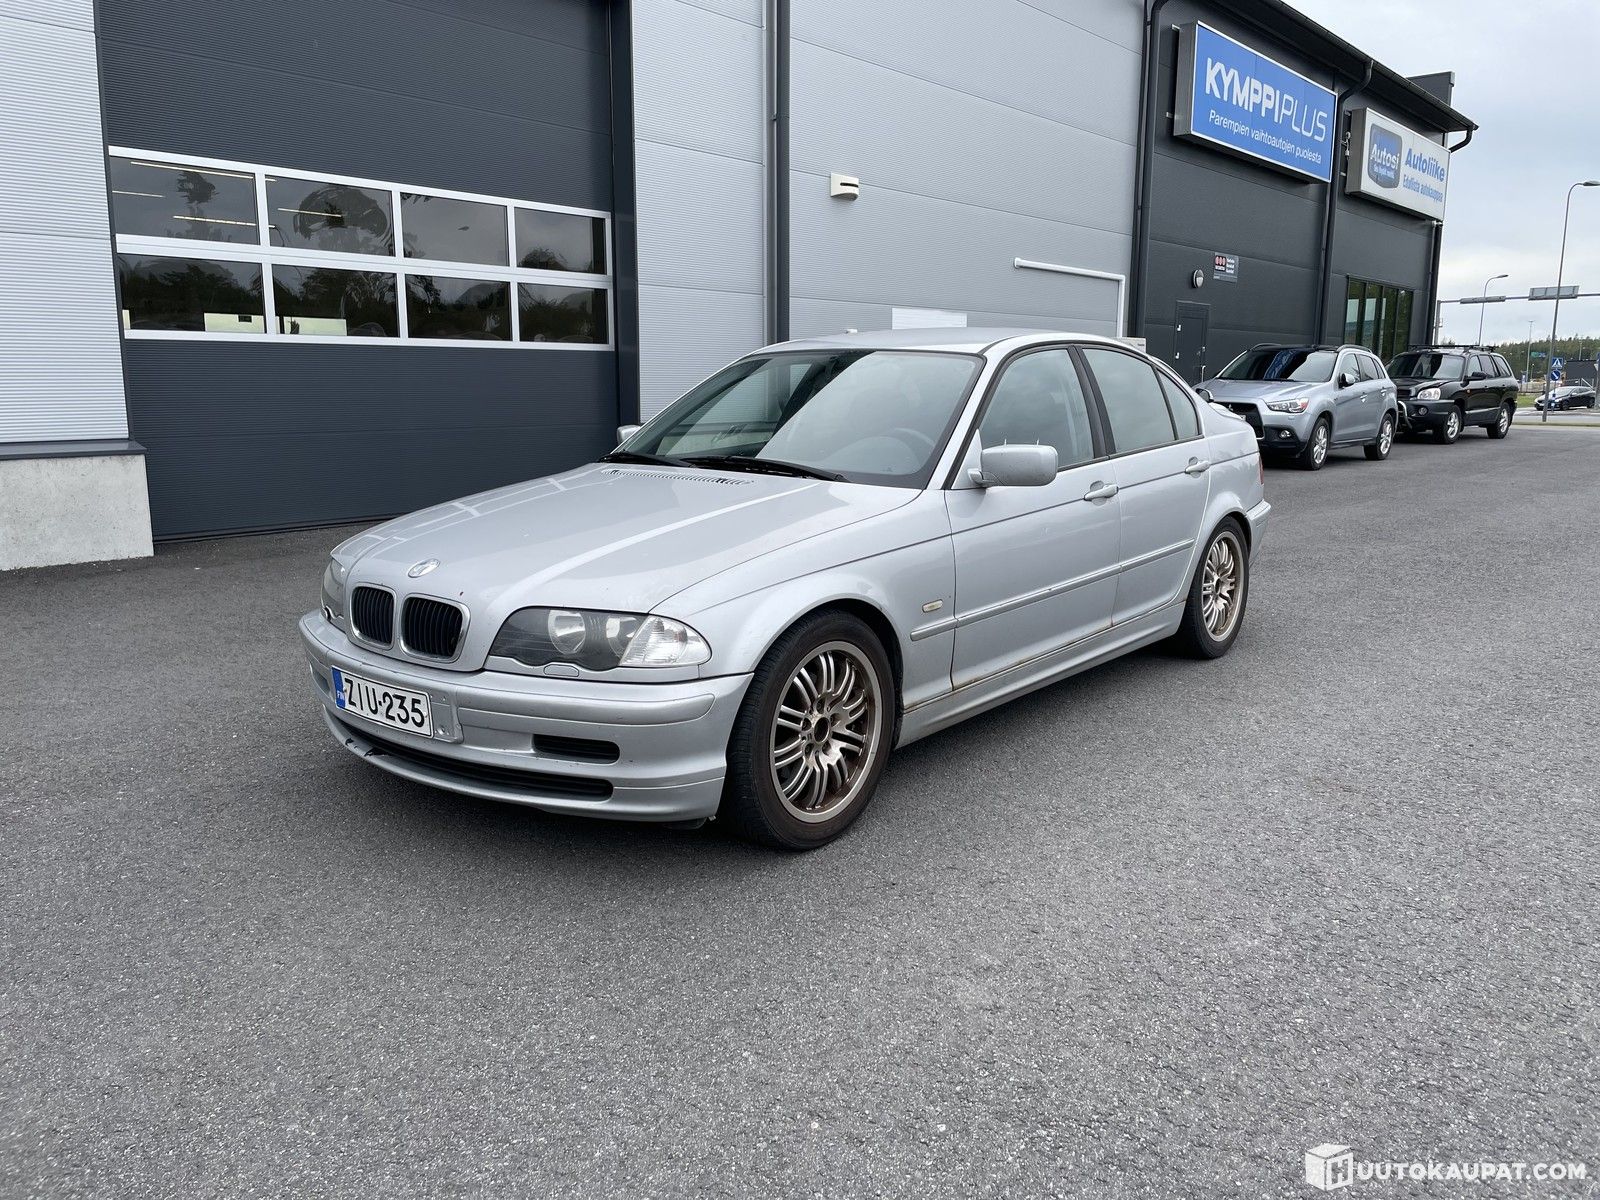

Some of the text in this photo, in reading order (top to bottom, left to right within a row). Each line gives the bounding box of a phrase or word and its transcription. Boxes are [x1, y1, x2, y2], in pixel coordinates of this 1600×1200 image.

[1208, 109, 1322, 165] Parempien vaihtoautojen puolesta
[1370, 143, 1400, 170] Autosi
[1404, 147, 1445, 182] Autoliike
[344, 677, 425, 728] ZIU-235
